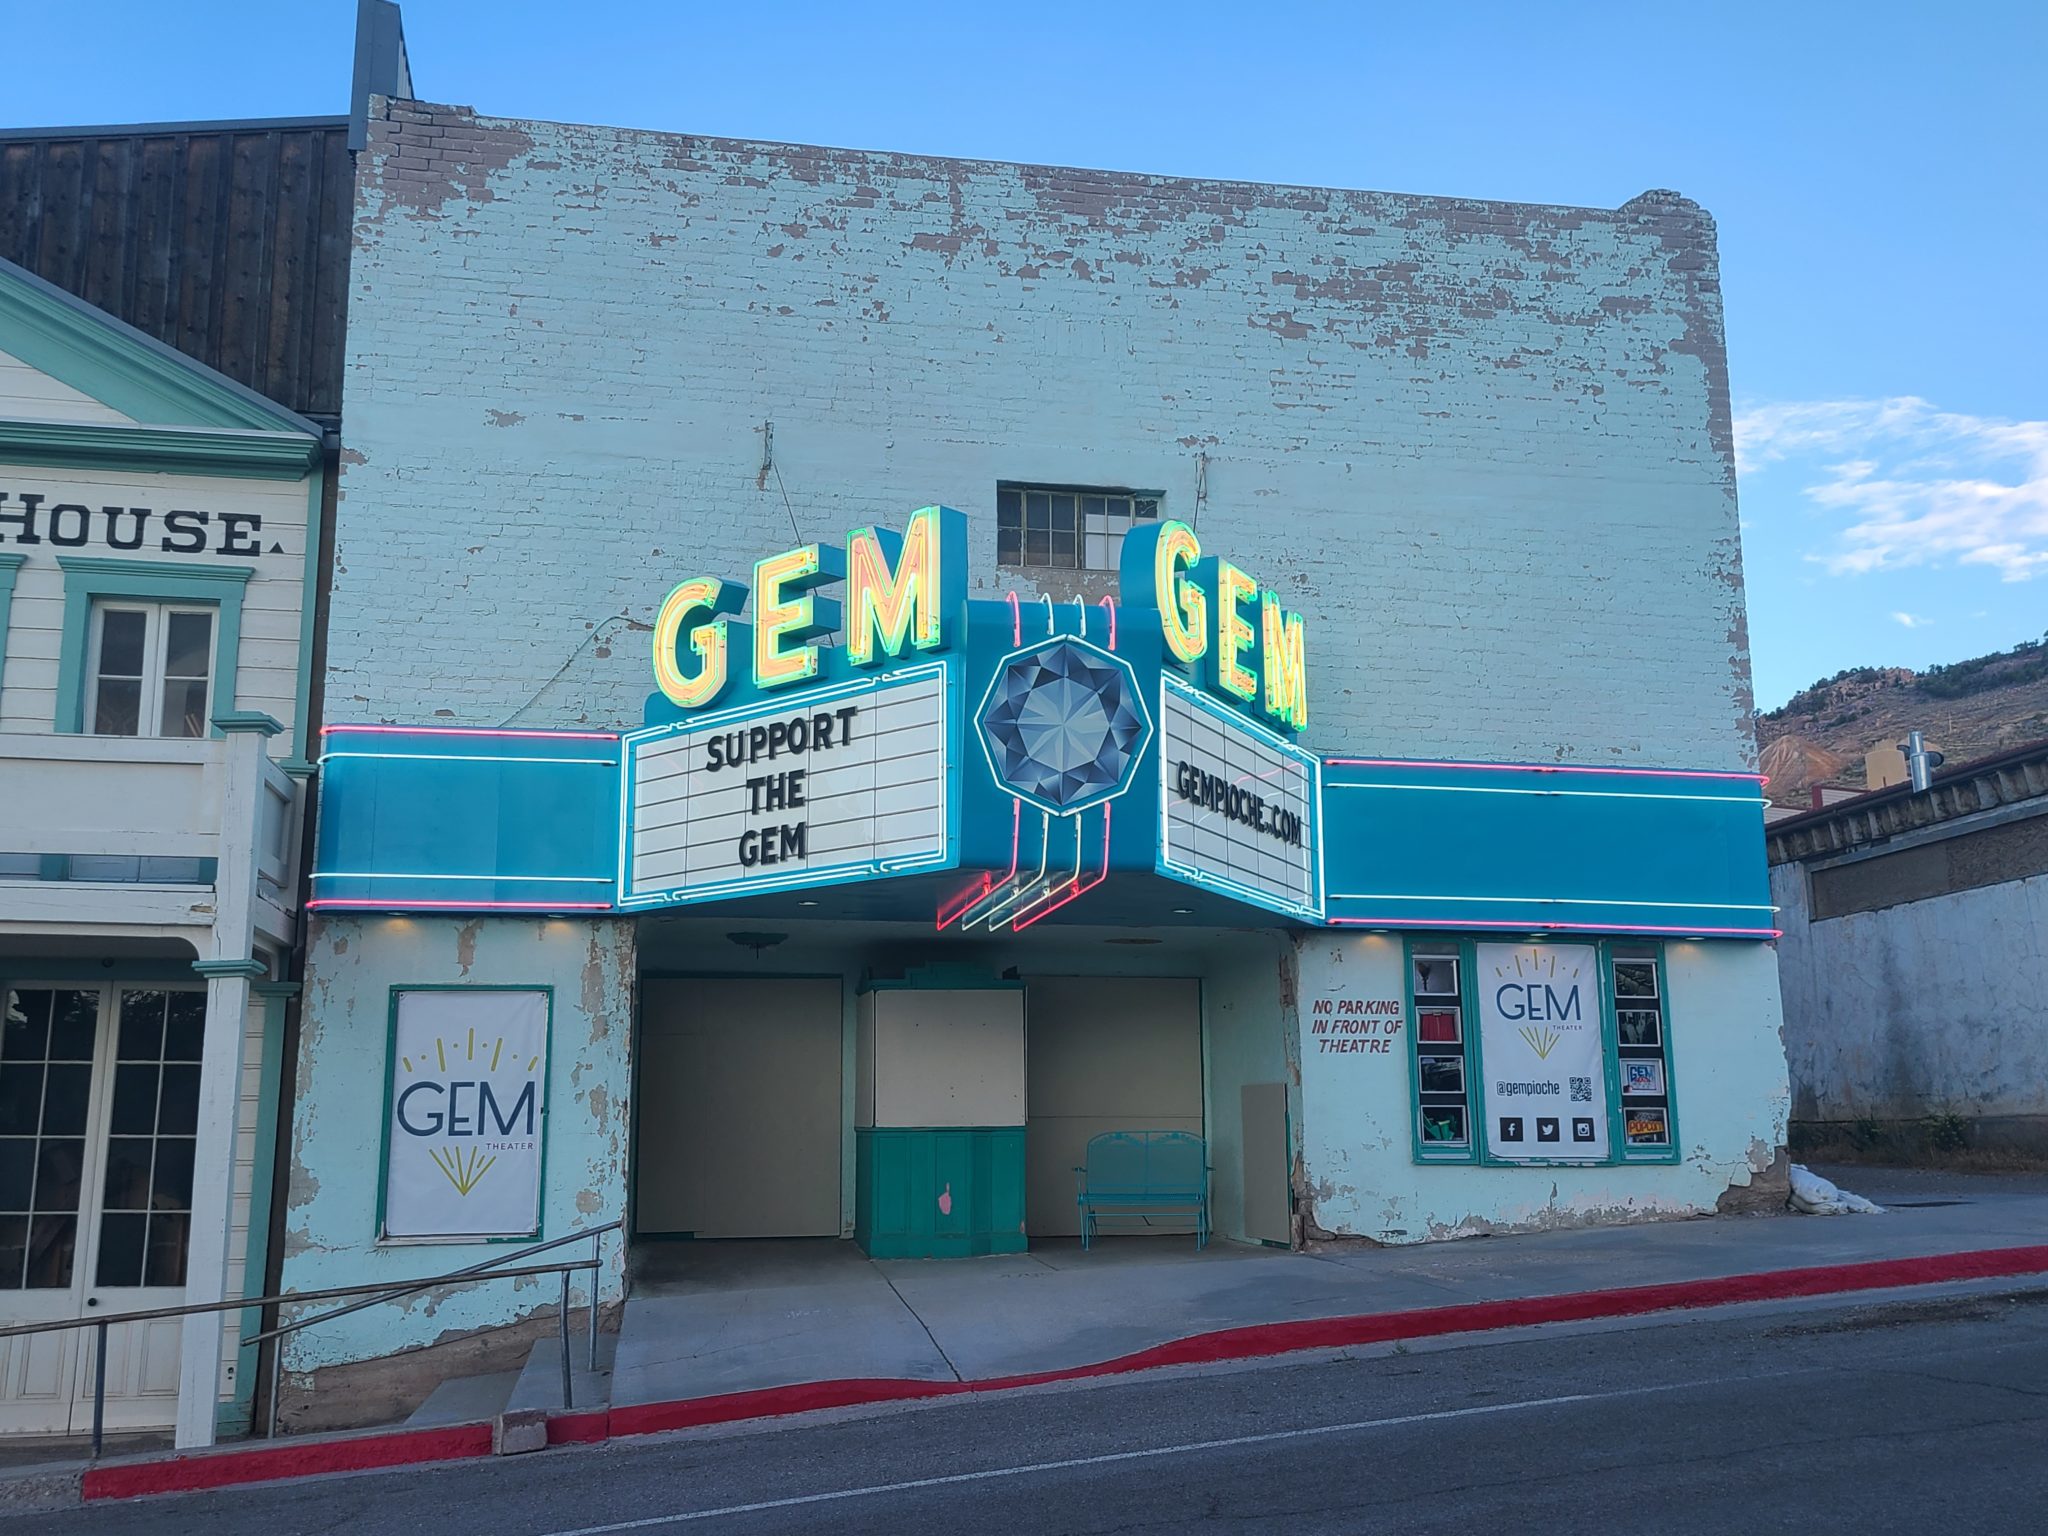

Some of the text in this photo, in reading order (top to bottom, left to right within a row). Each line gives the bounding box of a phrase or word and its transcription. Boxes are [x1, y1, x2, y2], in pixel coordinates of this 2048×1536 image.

[0, 492, 261, 557] HOUSE
[653, 505, 942, 708] GEM
[1155, 519, 1308, 732] GEM
[705, 706, 858, 772] SUPPORT
[746, 769, 806, 815] THE
[1177, 760, 1302, 849] GEMPIOCHE.COM
[738, 822, 807, 867] GEM
[1312, 1000, 1400, 1015] NO PARKING
[1496, 983, 1582, 1021] GEM
[1311, 1019, 1403, 1034] IN FRONT OF
[1319, 1039, 1392, 1053] THEATRE
[397, 1081, 535, 1136] GEM
[1496, 1080, 1560, 1097] @gempioche
[486, 1142, 534, 1150] THEATER
